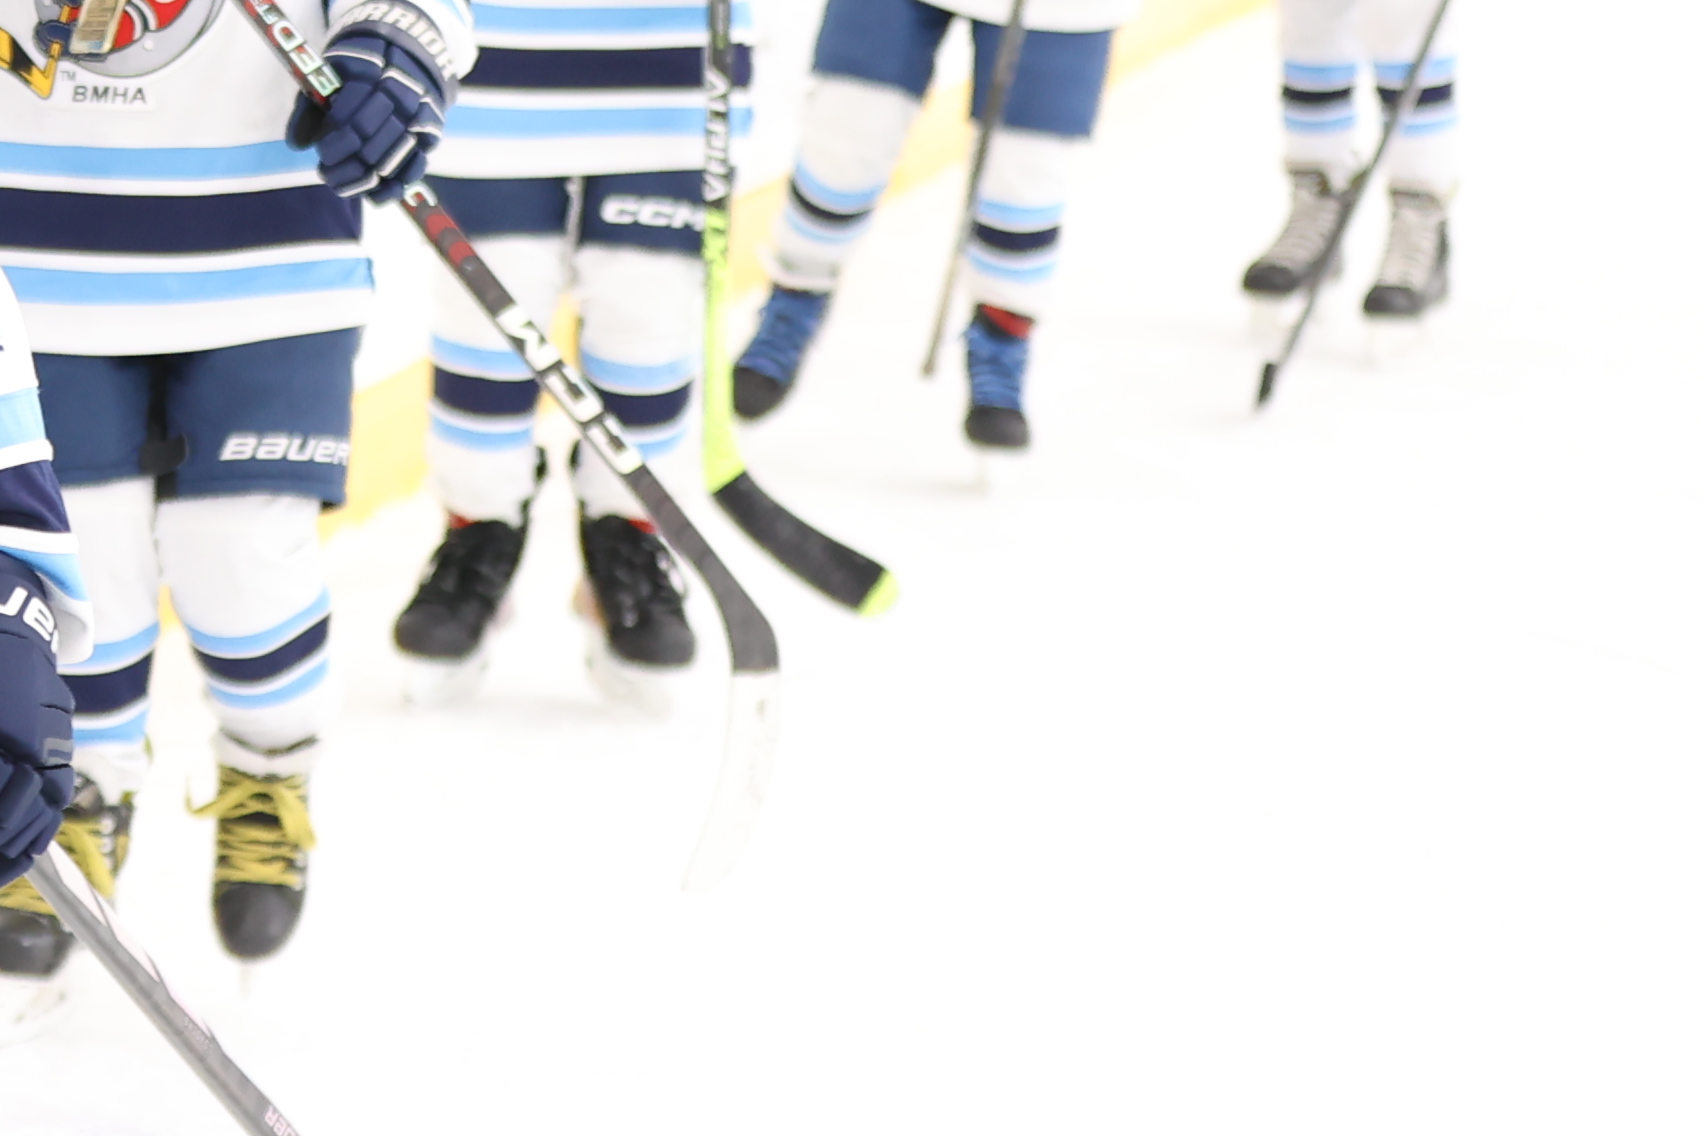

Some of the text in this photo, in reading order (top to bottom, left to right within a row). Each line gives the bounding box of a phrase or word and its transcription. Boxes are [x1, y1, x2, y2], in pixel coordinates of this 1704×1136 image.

[334, 1, 456, 82] ARRIOR
[72, 85, 148, 104] BMHA
[495, 304, 643, 475] CCM
